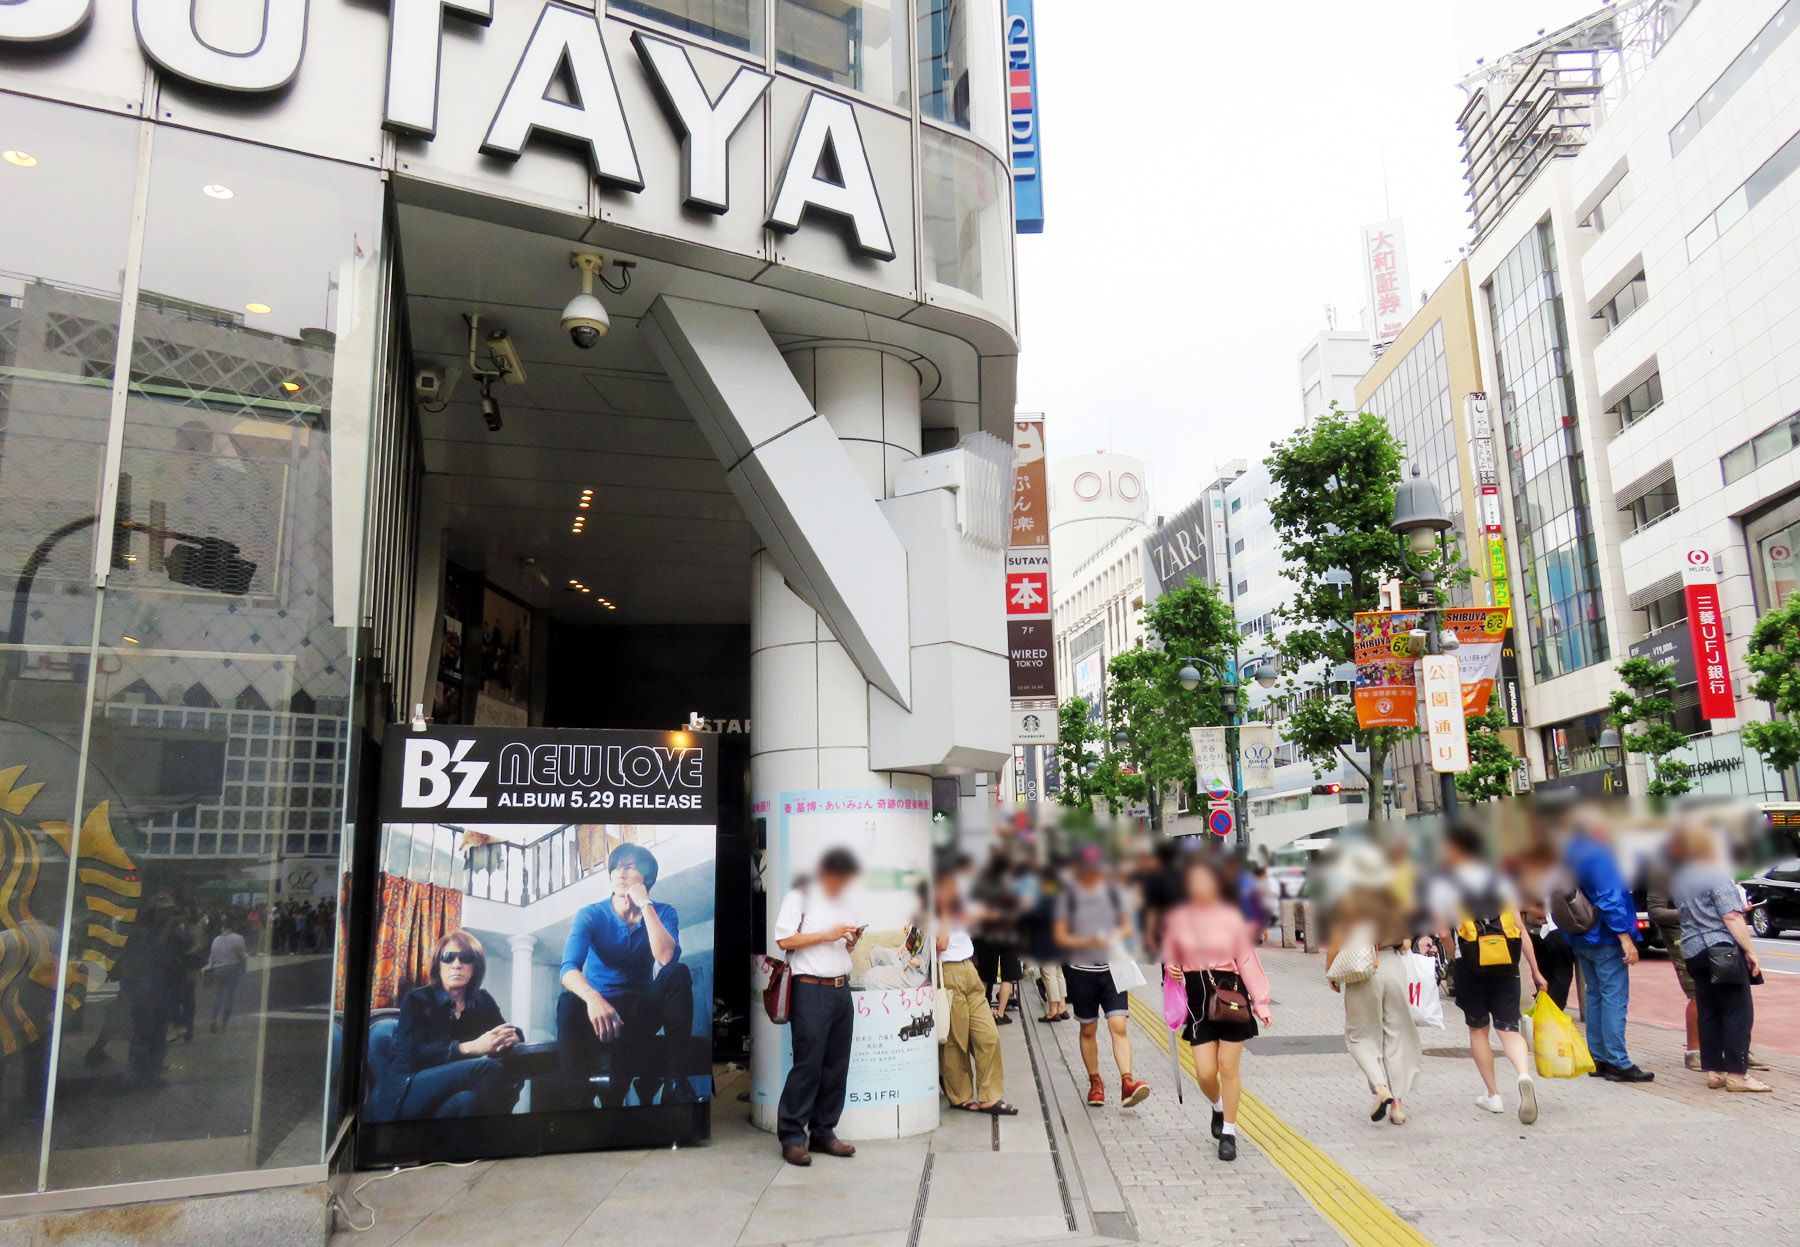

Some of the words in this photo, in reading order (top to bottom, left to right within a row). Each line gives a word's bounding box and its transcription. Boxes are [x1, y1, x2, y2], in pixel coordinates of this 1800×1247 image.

[1371, 230, 1402, 316] 大和証券
[1008, 556, 1048, 566] SUTAYA
[1153, 521, 1207, 582] ZARA
[1010, 577, 1043, 609] 本
[1446, 612, 1486, 621] SHIBUYA
[1487, 619, 1503, 628] 6/2
[1022, 626, 1034, 634] 7F
[1354, 637, 1391, 650] SHIBUYA
[1697, 596, 1726, 695] 三菱UFJ銀行
[1011, 648, 1047, 659] WIRED
[1016, 659, 1043, 668] TOKYO
[1508, 681, 1519, 723] McDonald's
[1429, 665, 1452, 760] 公園通り
[401, 738, 490, 809] B'z
[499, 742, 602, 787] NEW
[607, 744, 703, 790] LOVE
[1698, 757, 1741, 776] COMPANY
[498, 795, 565, 808] ALBUM
[570, 790, 614, 809] 5.29
[620, 795, 702, 809] RELEASE
